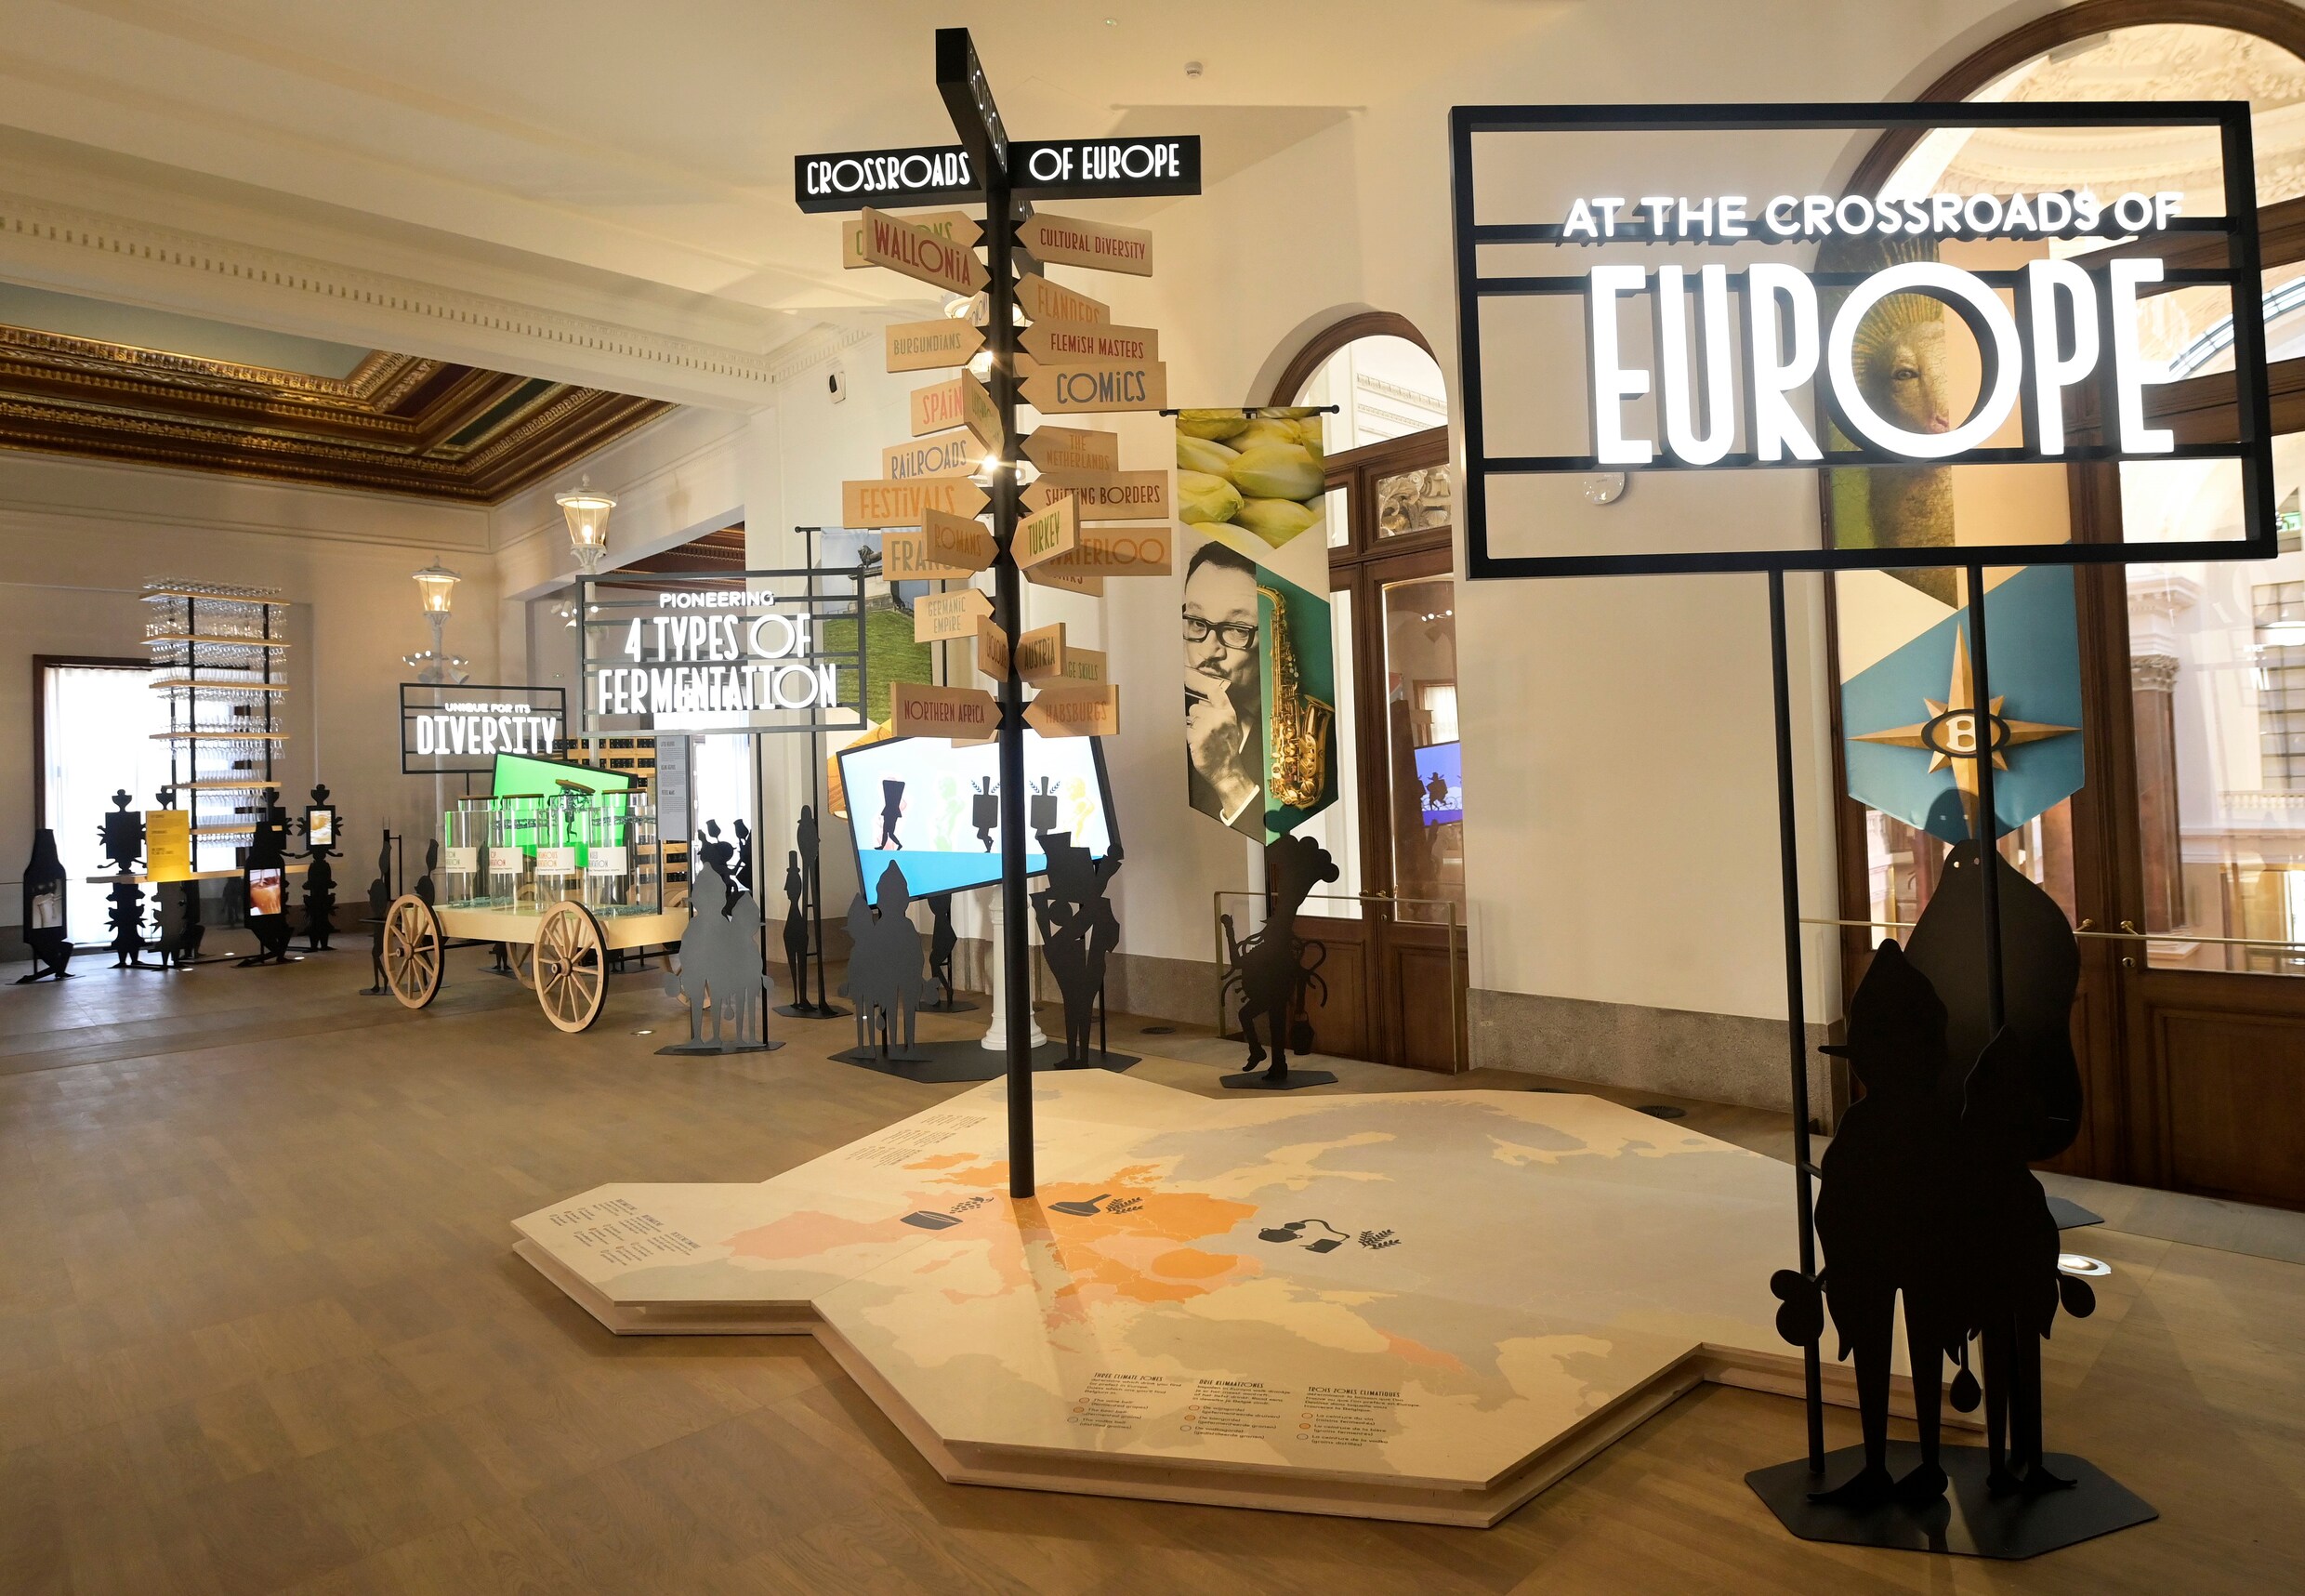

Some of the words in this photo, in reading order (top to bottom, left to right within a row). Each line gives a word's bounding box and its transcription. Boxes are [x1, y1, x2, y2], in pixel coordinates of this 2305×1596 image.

[807, 151, 971, 195] CROSSROADS
[1029, 146, 1073, 182] OF
[1082, 143, 1180, 180] EUROPE
[1562, 196, 1626, 239] AT
[1641, 195, 1747, 238] THE
[1765, 191, 2101, 237] CROSSROADS
[2114, 191, 2185, 233] OF
[1040, 228, 1091, 254] CULTURAL
[1099, 337, 1144, 360] MASTERS
[1588, 257, 2176, 467] EUROPE
[1069, 434, 1087, 451] THE
[1046, 450, 1111, 471] NETHERLANDS
[1100, 485, 1161, 505] BORDERS
[934, 523, 982, 557] ROMANS
[1027, 510, 1060, 557] TURKEY
[660, 590, 774, 609] PIONEERING
[625, 616, 640, 663] 4
[653, 614, 739, 662] TYPES
[750, 612, 812, 659] OF
[598, 662, 838, 716] FERMENTATION
[444, 703, 489, 713] UNIQUE
[491, 704, 512, 713] FOR
[514, 704, 532, 714] ITS
[904, 699, 955, 723] NORTHERN
[1046, 703, 1108, 724] HABSBURGS
[416, 715, 557, 755] DIVERSITY
